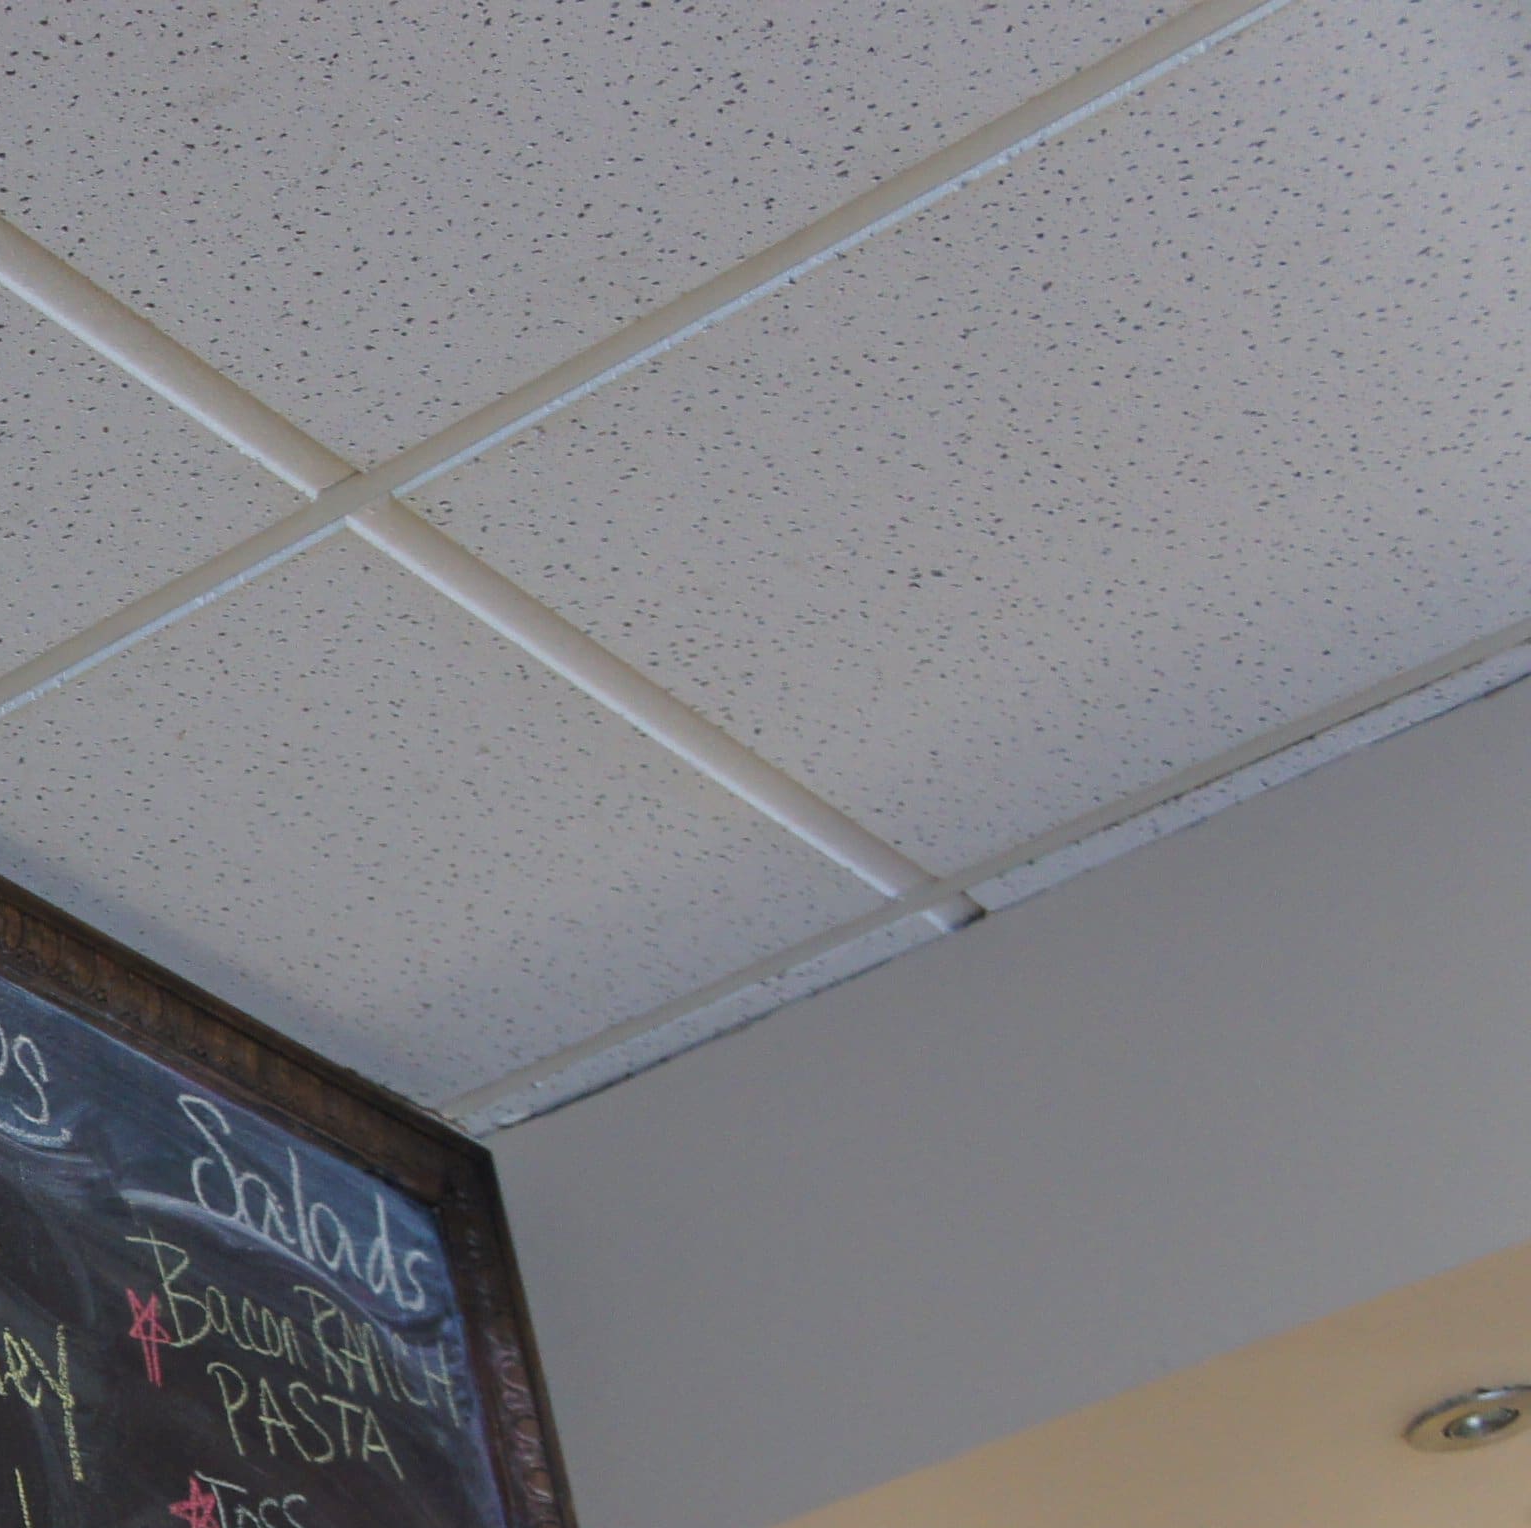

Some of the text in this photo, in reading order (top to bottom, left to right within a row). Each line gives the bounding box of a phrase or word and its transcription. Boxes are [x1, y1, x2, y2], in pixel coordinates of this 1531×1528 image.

[177, 1093, 433, 1312] Salads
[125, 1228, 308, 1370] Bacon
[206, 1361, 405, 1481] PASTA
